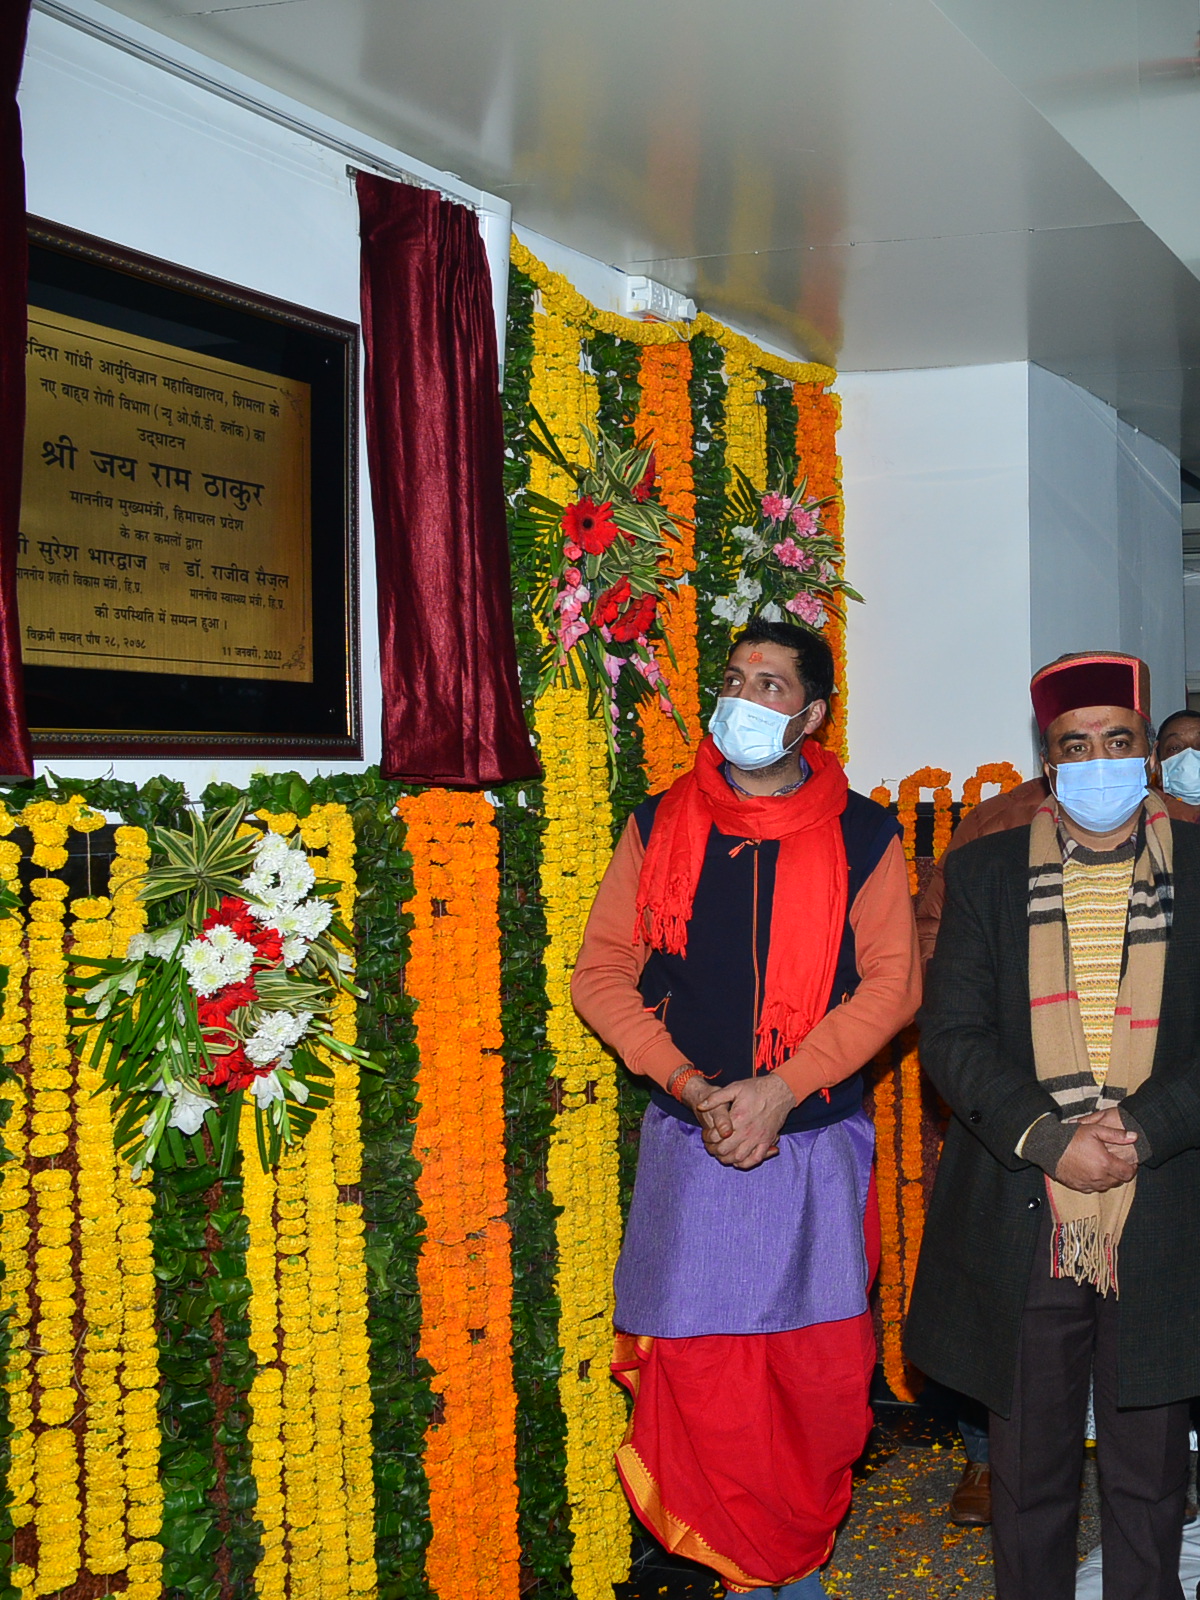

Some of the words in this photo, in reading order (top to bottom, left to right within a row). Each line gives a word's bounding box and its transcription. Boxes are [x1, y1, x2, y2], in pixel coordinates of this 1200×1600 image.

[64, 349, 93, 370] गांधी
[232, 390, 265, 413] शिमला
[269, 399, 280, 417] के
[39, 377, 57, 399] नए
[93, 385, 115, 407] रोगी
[119, 392, 150, 416] विभाग
[253, 428, 266, 442] का
[41, 434, 79, 471] श्री
[90, 450, 138, 482] जय
[148, 462, 192, 493] राम
[201, 472, 266, 511] ठाकुर
[69, 490, 113, 509] माननीय
[173, 504, 216, 526] हिमाचल
[220, 513, 244, 531] प्रदेश
[119, 524, 130, 540] के
[134, 529, 150, 542] कर
[37, 536, 80, 565] सुरेश
[88, 548, 148, 571] भारद्वाज
[184, 558, 204, 579] डॉ.
[211, 562, 250, 584] राजीव
[48, 569, 70, 585] शहरी
[73, 570, 100, 588] विकास
[26, 625, 56, 642] विक्रमी
[94, 602, 109, 619] की
[157, 607, 168, 624] में
[201, 616, 220, 633] हुआ
[222, 646, 231, 656] 11
[264, 649, 282, 661] 2022
